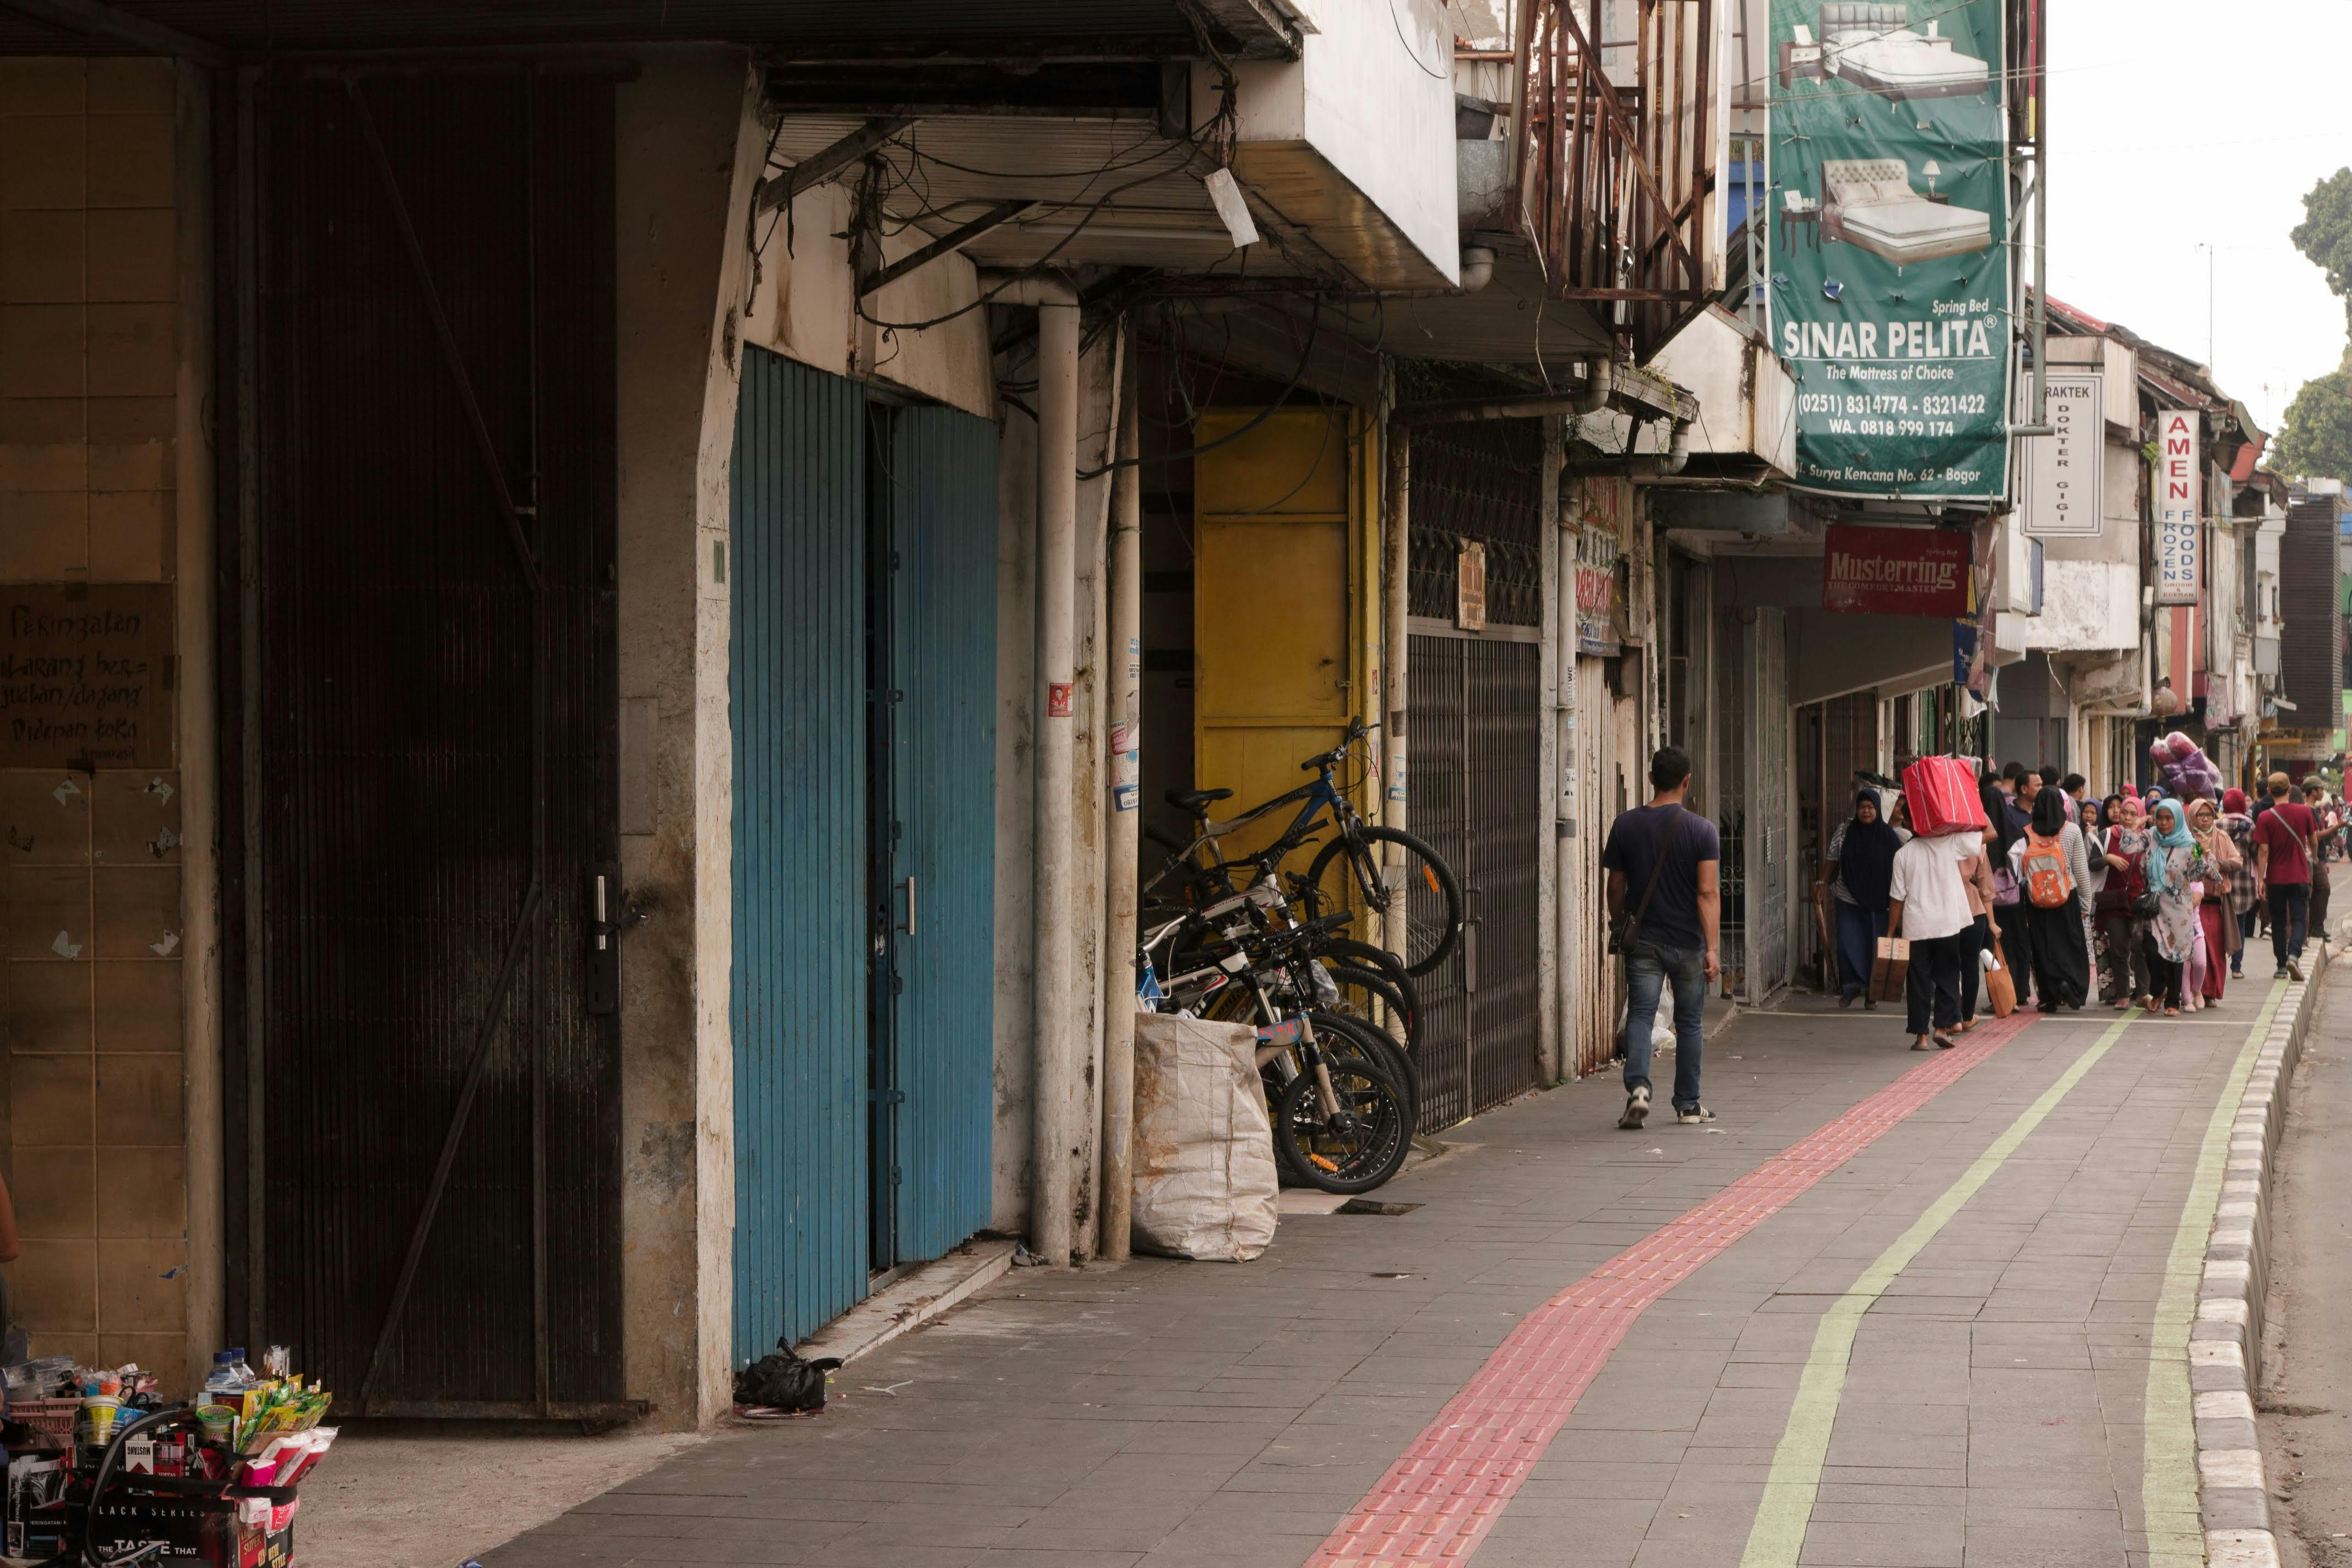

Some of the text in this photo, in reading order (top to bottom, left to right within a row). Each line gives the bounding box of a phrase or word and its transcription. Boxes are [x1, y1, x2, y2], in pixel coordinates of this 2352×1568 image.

[1932, 298, 1989, 316] Spring Bed
[1784, 320, 1990, 357] SINAR PELITA
[1826, 365, 1954, 380] The Mattress of Choice
[2045, 386, 2089, 398] RAKTEK
[1798, 394, 1842, 417] (0251)
[1847, 395, 1907, 414] 8314774
[1923, 394, 1985, 414] 8321422
[1829, 419, 1954, 437] WA. 0818 999 174
[2168, 416, 2190, 499] AMEN
[1810, 465, 1841, 481] Surya
[1844, 466, 1894, 482] Kencana
[1898, 469, 1917, 482] No.
[1920, 470, 1934, 481] 62
[1946, 467, 1980, 484] Bogor
[2164, 510, 2176, 580] FROZEN
[2180, 510, 2195, 580] FOODS
[1831, 552, 1957, 589] Musterring
[127, 1446, 151, 1455] MUSTANG
[88, 1506, 205, 1517] LACK SERIES
[244, 1534, 262, 1555] SUPER
[268, 1543, 279, 1561] NEW
